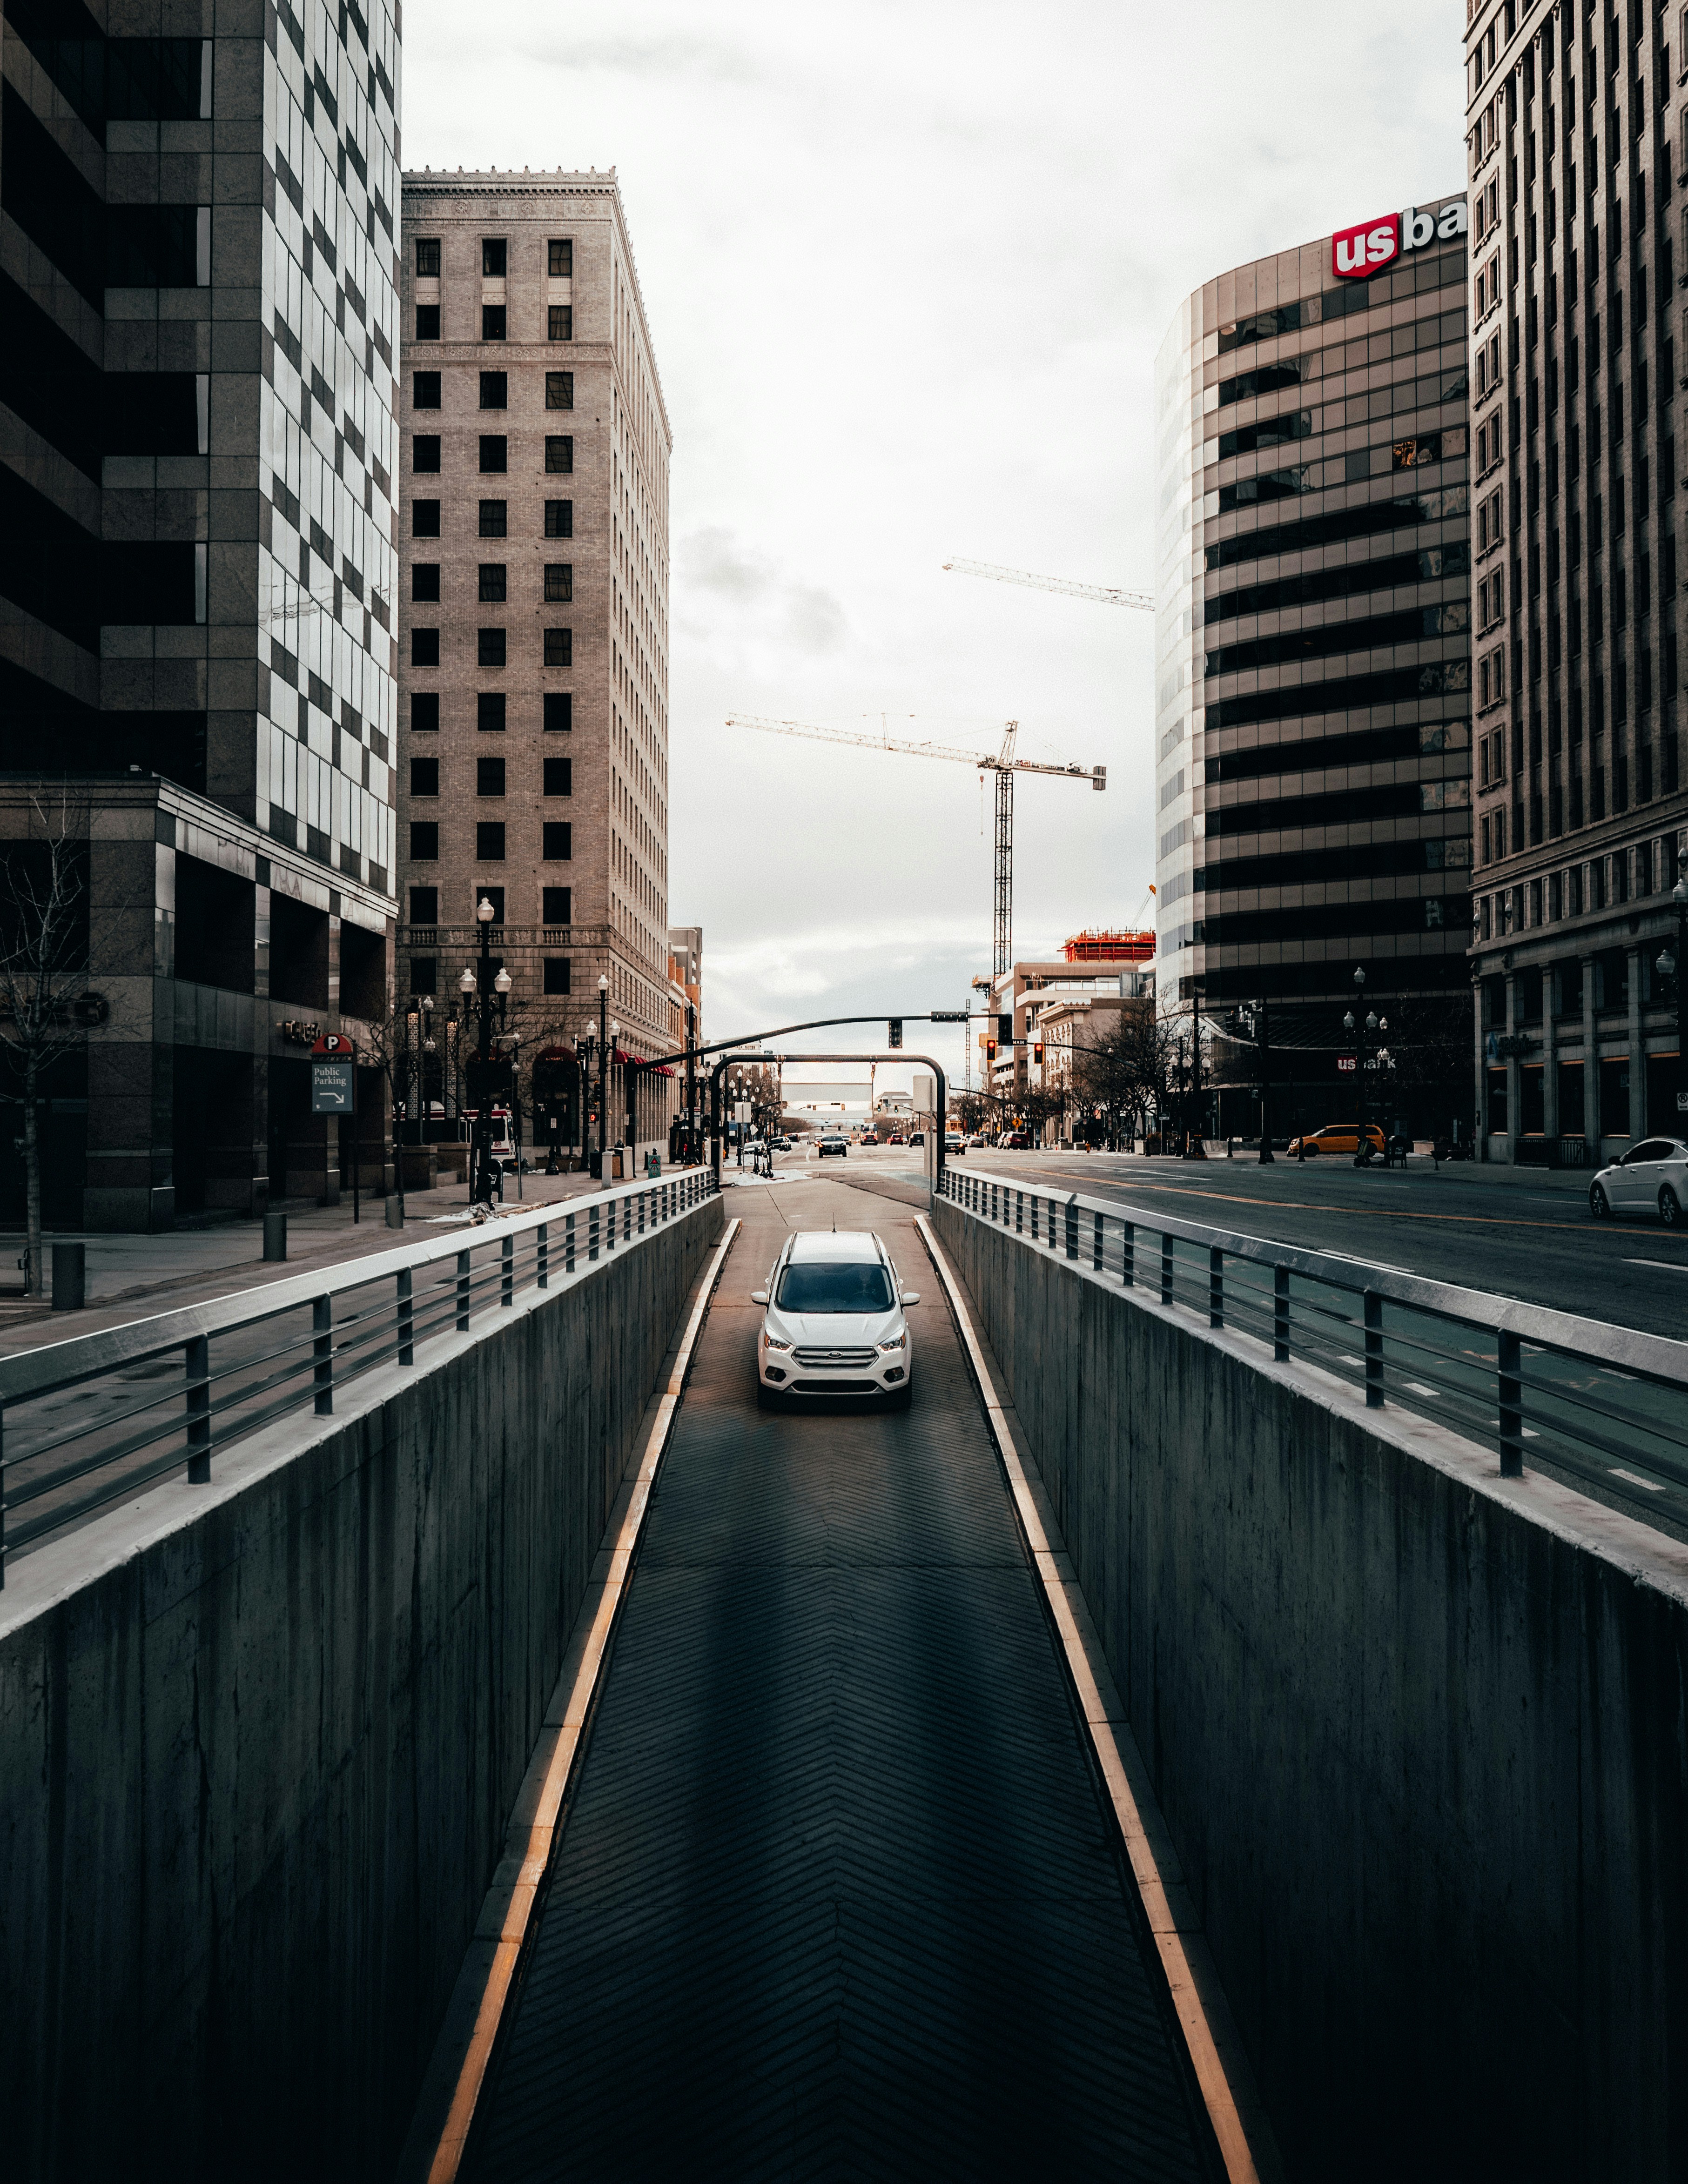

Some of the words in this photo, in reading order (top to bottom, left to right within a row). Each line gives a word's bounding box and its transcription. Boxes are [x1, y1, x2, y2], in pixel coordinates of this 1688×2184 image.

[1337, 226, 1395, 272] us
[328, 1036, 338, 1049] P
[1338, 1059, 1356, 1070] us
[314, 1067, 340, 1076] Public
[314, 1076, 346, 1087] Parking
